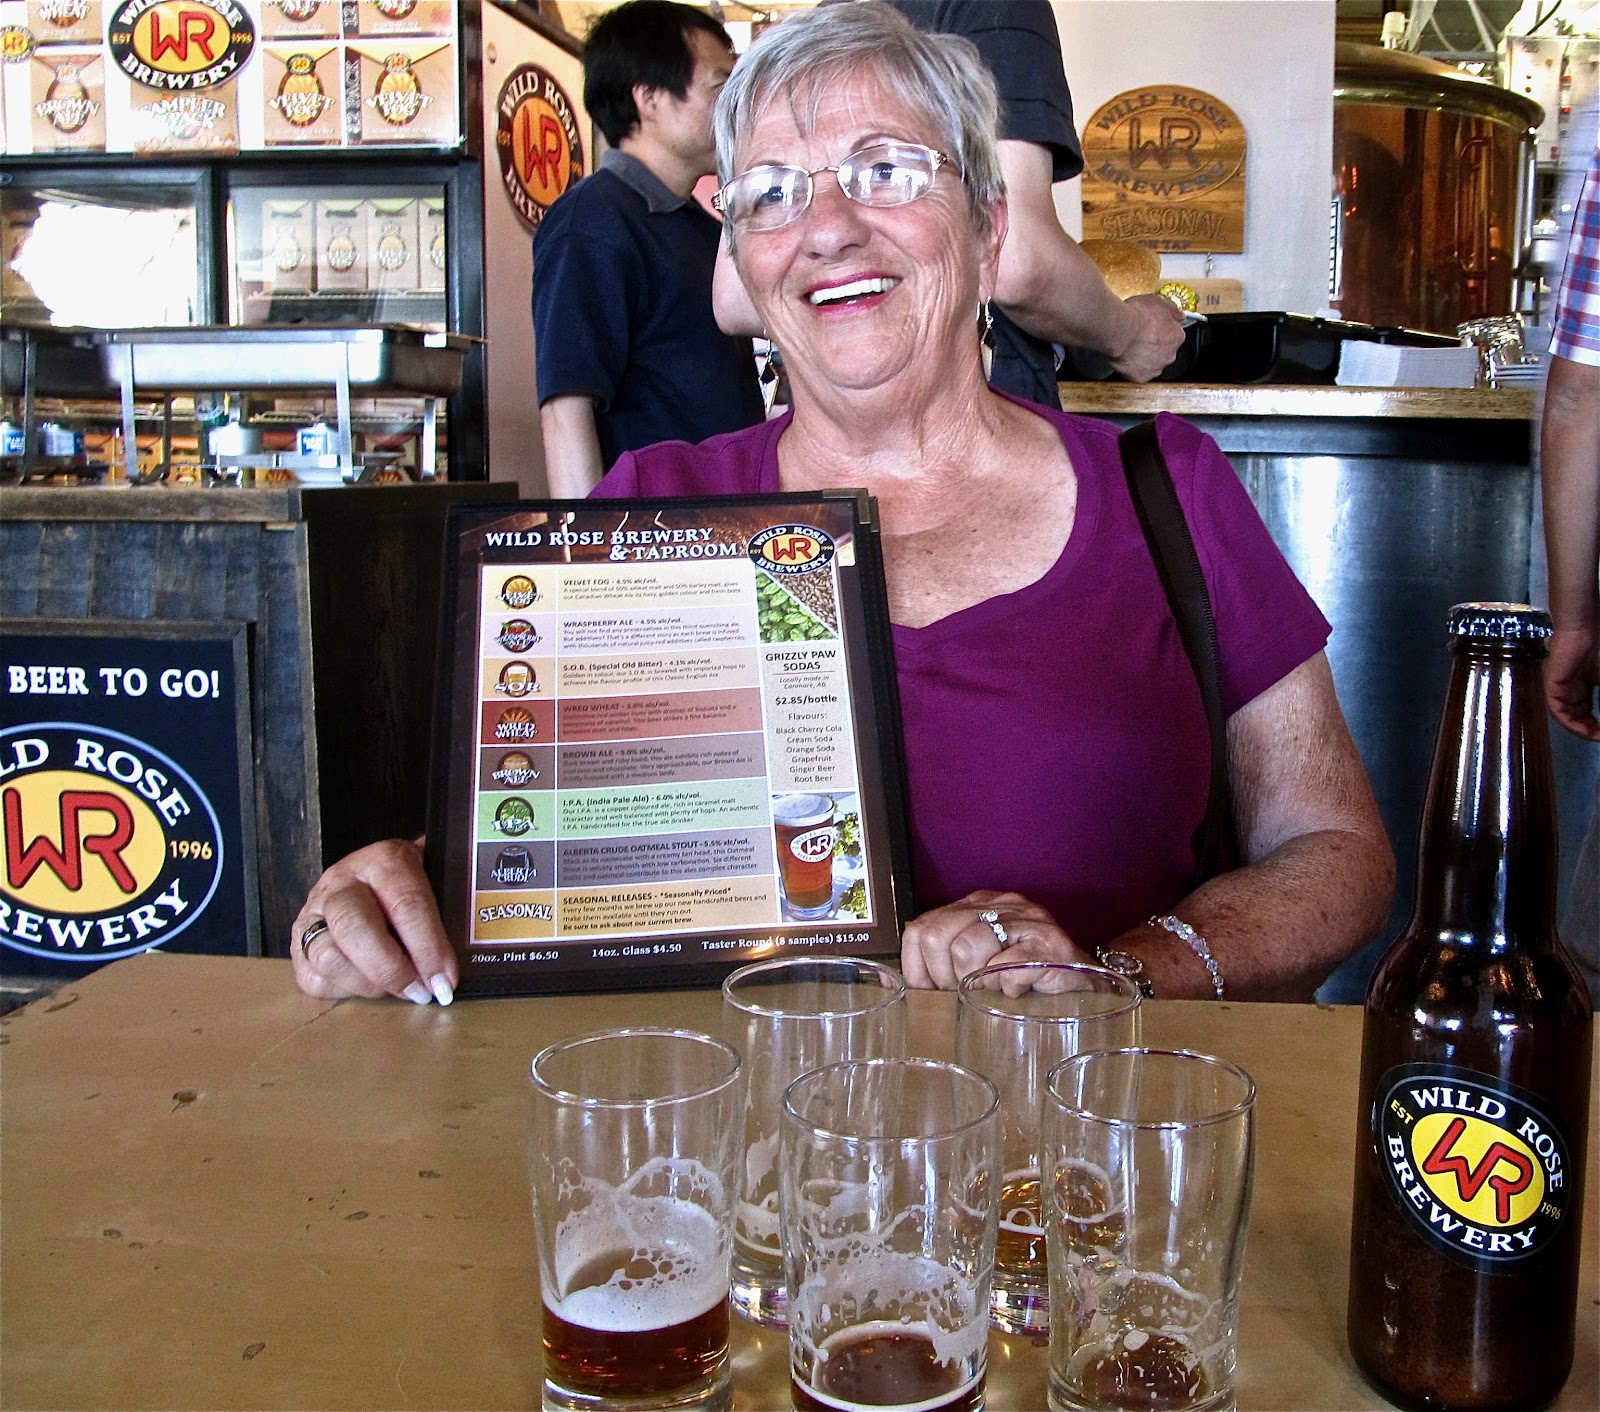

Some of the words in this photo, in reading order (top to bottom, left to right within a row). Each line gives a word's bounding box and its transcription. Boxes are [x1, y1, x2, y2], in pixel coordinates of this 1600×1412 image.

[150, 10, 215, 62] WR
[121, 52, 240, 90] BREWERY
[501, 71, 539, 119] WILD
[544, 78, 578, 150] ROSE
[1096, 92, 1159, 131] WILD
[1171, 92, 1234, 133] ROSE
[1128, 116, 1202, 170] WR
[1101, 160, 1226, 197] BREWERY
[1101, 207, 1227, 241] SEASONAL
[485, 531, 542, 547] WILD
[549, 531, 604, 547] ROSE
[611, 528, 714, 546] BREWERY
[753, 527, 787, 547] WILD
[793, 526, 827, 545] ROSE
[609, 544, 630, 561] &
[633, 543, 738, 560] TAPROOM
[772, 537, 813, 561] WR
[756, 554, 828, 574] BREWERY
[563, 619, 617, 628] WRASPBERRY
[765, 651, 808, 662] GRIZZLY
[811, 650, 836, 660] PAW
[589, 662, 620, 672] (Special
[621, 660, 636, 669] Old
[637, 660, 663, 670] Bitter)
[783, 661, 821, 672] SODAS
[8, 665, 89, 696] BEER
[99, 668, 148, 697] TO
[160, 669, 220, 698] GO!
[779, 676, 802, 685] Locally
[803, 675, 822, 683] made
[590, 703, 620, 711] WHEAT
[775, 694, 838, 706] $2.85/bottle
[788, 712, 828, 721] Flavours:
[775, 725, 796, 735] Black
[797, 725, 824, 735] Cherry
[825, 724, 843, 733] Cola
[785, 745, 815, 754] Orange
[816, 744, 836, 752] Soda
[786, 735, 812, 744] Cream
[813, 735, 834, 743] Soda
[563, 751, 596, 759] BROWN
[598, 749, 614, 757] ALE
[791, 754, 832, 764] Grapefruit
[789, 764, 816, 774] Ginger
[817, 763, 836, 772] Beer
[74, 738, 191, 827] ROSE
[794, 775, 813, 784] Root
[814, 774, 833, 783] Beer
[563, 799, 585, 807] I.P.A.
[586, 797, 611, 807] (India
[612, 796, 631, 804] Pale
[632, 794, 650, 803] Ale)
[656, 794, 674, 802] 6.0%
[562, 815, 594, 823] character
[609, 813, 623, 821] well
[654, 810, 669, 818] with
[2, 786, 138, 894] WR
[563, 847, 599, 856] ALBERTA
[600, 845, 629, 855] CRUDE
[630, 843, 671, 853] OATMEAL
[671, 841, 699, 850] STOUT
[704, 840, 722, 848] 5.5%
[723, 837, 750, 847] alc/vol.
[169, 840, 213, 860] 1996
[563, 895, 610, 906] SEASONAL
[611, 892, 653, 903] RELEASES
[563, 906, 582, 914] Every
[583, 905, 596, 913] few
[597, 904, 623, 912] months
[693, 896, 733, 905] handcrafted
[734, 894, 753, 902] beers
[479, 903, 553, 923] SEASONAL
[563, 914, 582, 922] make
[583, 913, 601, 921] them
[602, 911, 632, 920] available
[633, 910, 649, 918] until
[650, 909, 665, 918] they
[612, 920, 633, 928] about
[647, 918, 673, 926] current
[591, 947, 620, 959] 14oz.
[622, 944, 651, 957] Glass
[652, 942, 683, 955] $4.50
[700, 939, 736, 951] Taster
[738, 936, 773, 949] Round
[788, 933, 834, 947] samples)
[835, 932, 870, 945] $15.00
[471, 953, 501, 965] 20oz.
[502, 950, 527, 962] Pint
[529, 949, 559, 961] $6.50
[1390, 1099, 1414, 1125] EST
[1410, 1086, 1507, 1120] WILD
[1516, 1116, 1563, 1193] ROSE
[1421, 1116, 1535, 1224] WR
[1387, 1132, 1537, 1252] BREWERY
[1540, 1201, 1562, 1220] 1996
